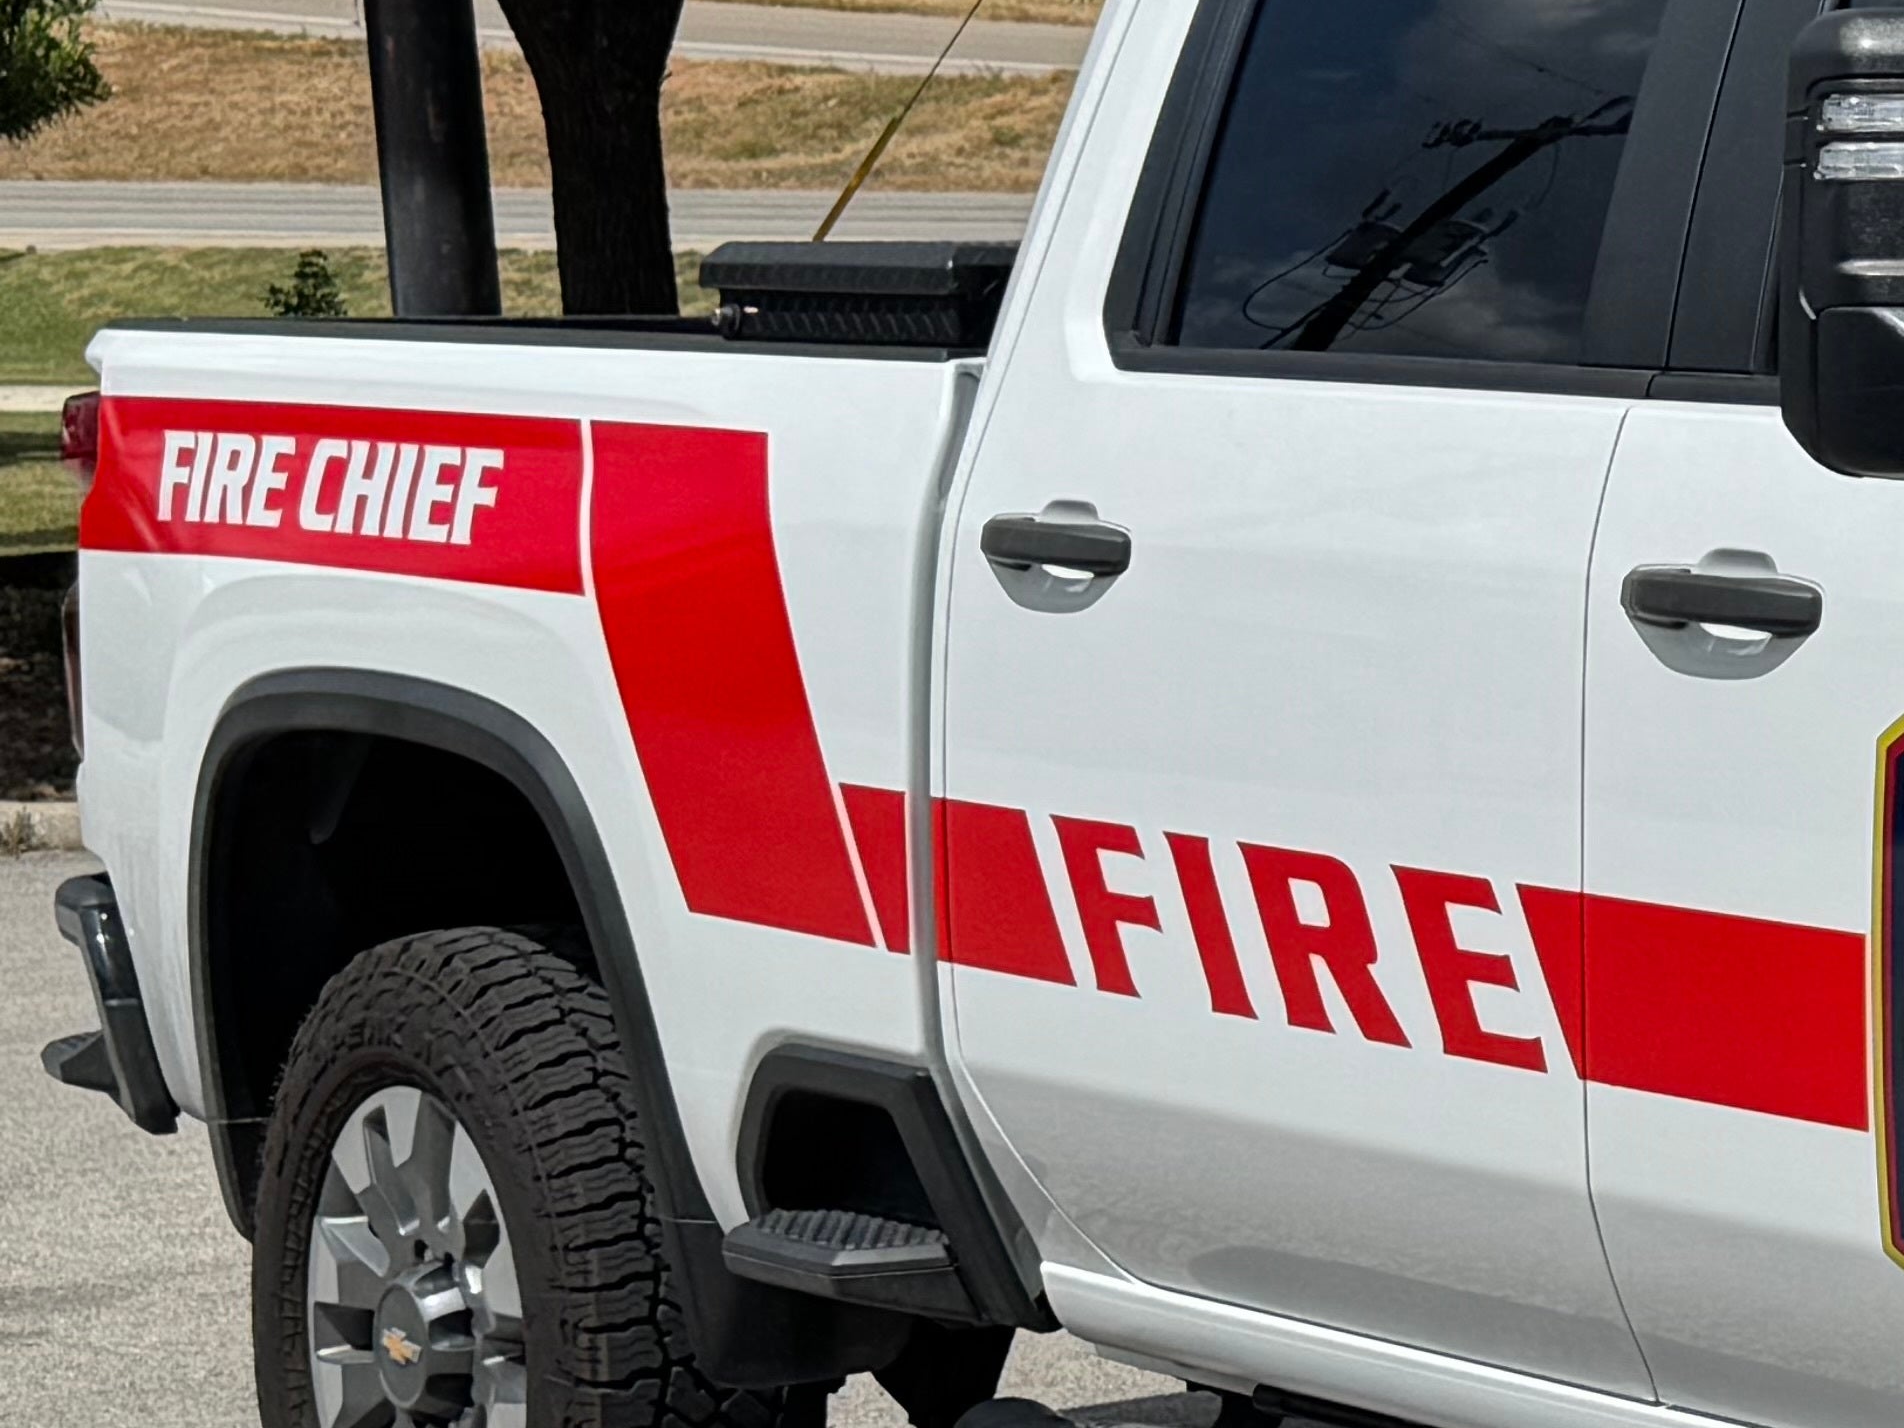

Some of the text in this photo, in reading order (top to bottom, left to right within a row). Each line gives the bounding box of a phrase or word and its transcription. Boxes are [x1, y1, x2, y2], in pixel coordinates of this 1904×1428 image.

[157, 429, 505, 546] FIRE CHIEF
[1049, 813, 1548, 1073] FIRE
